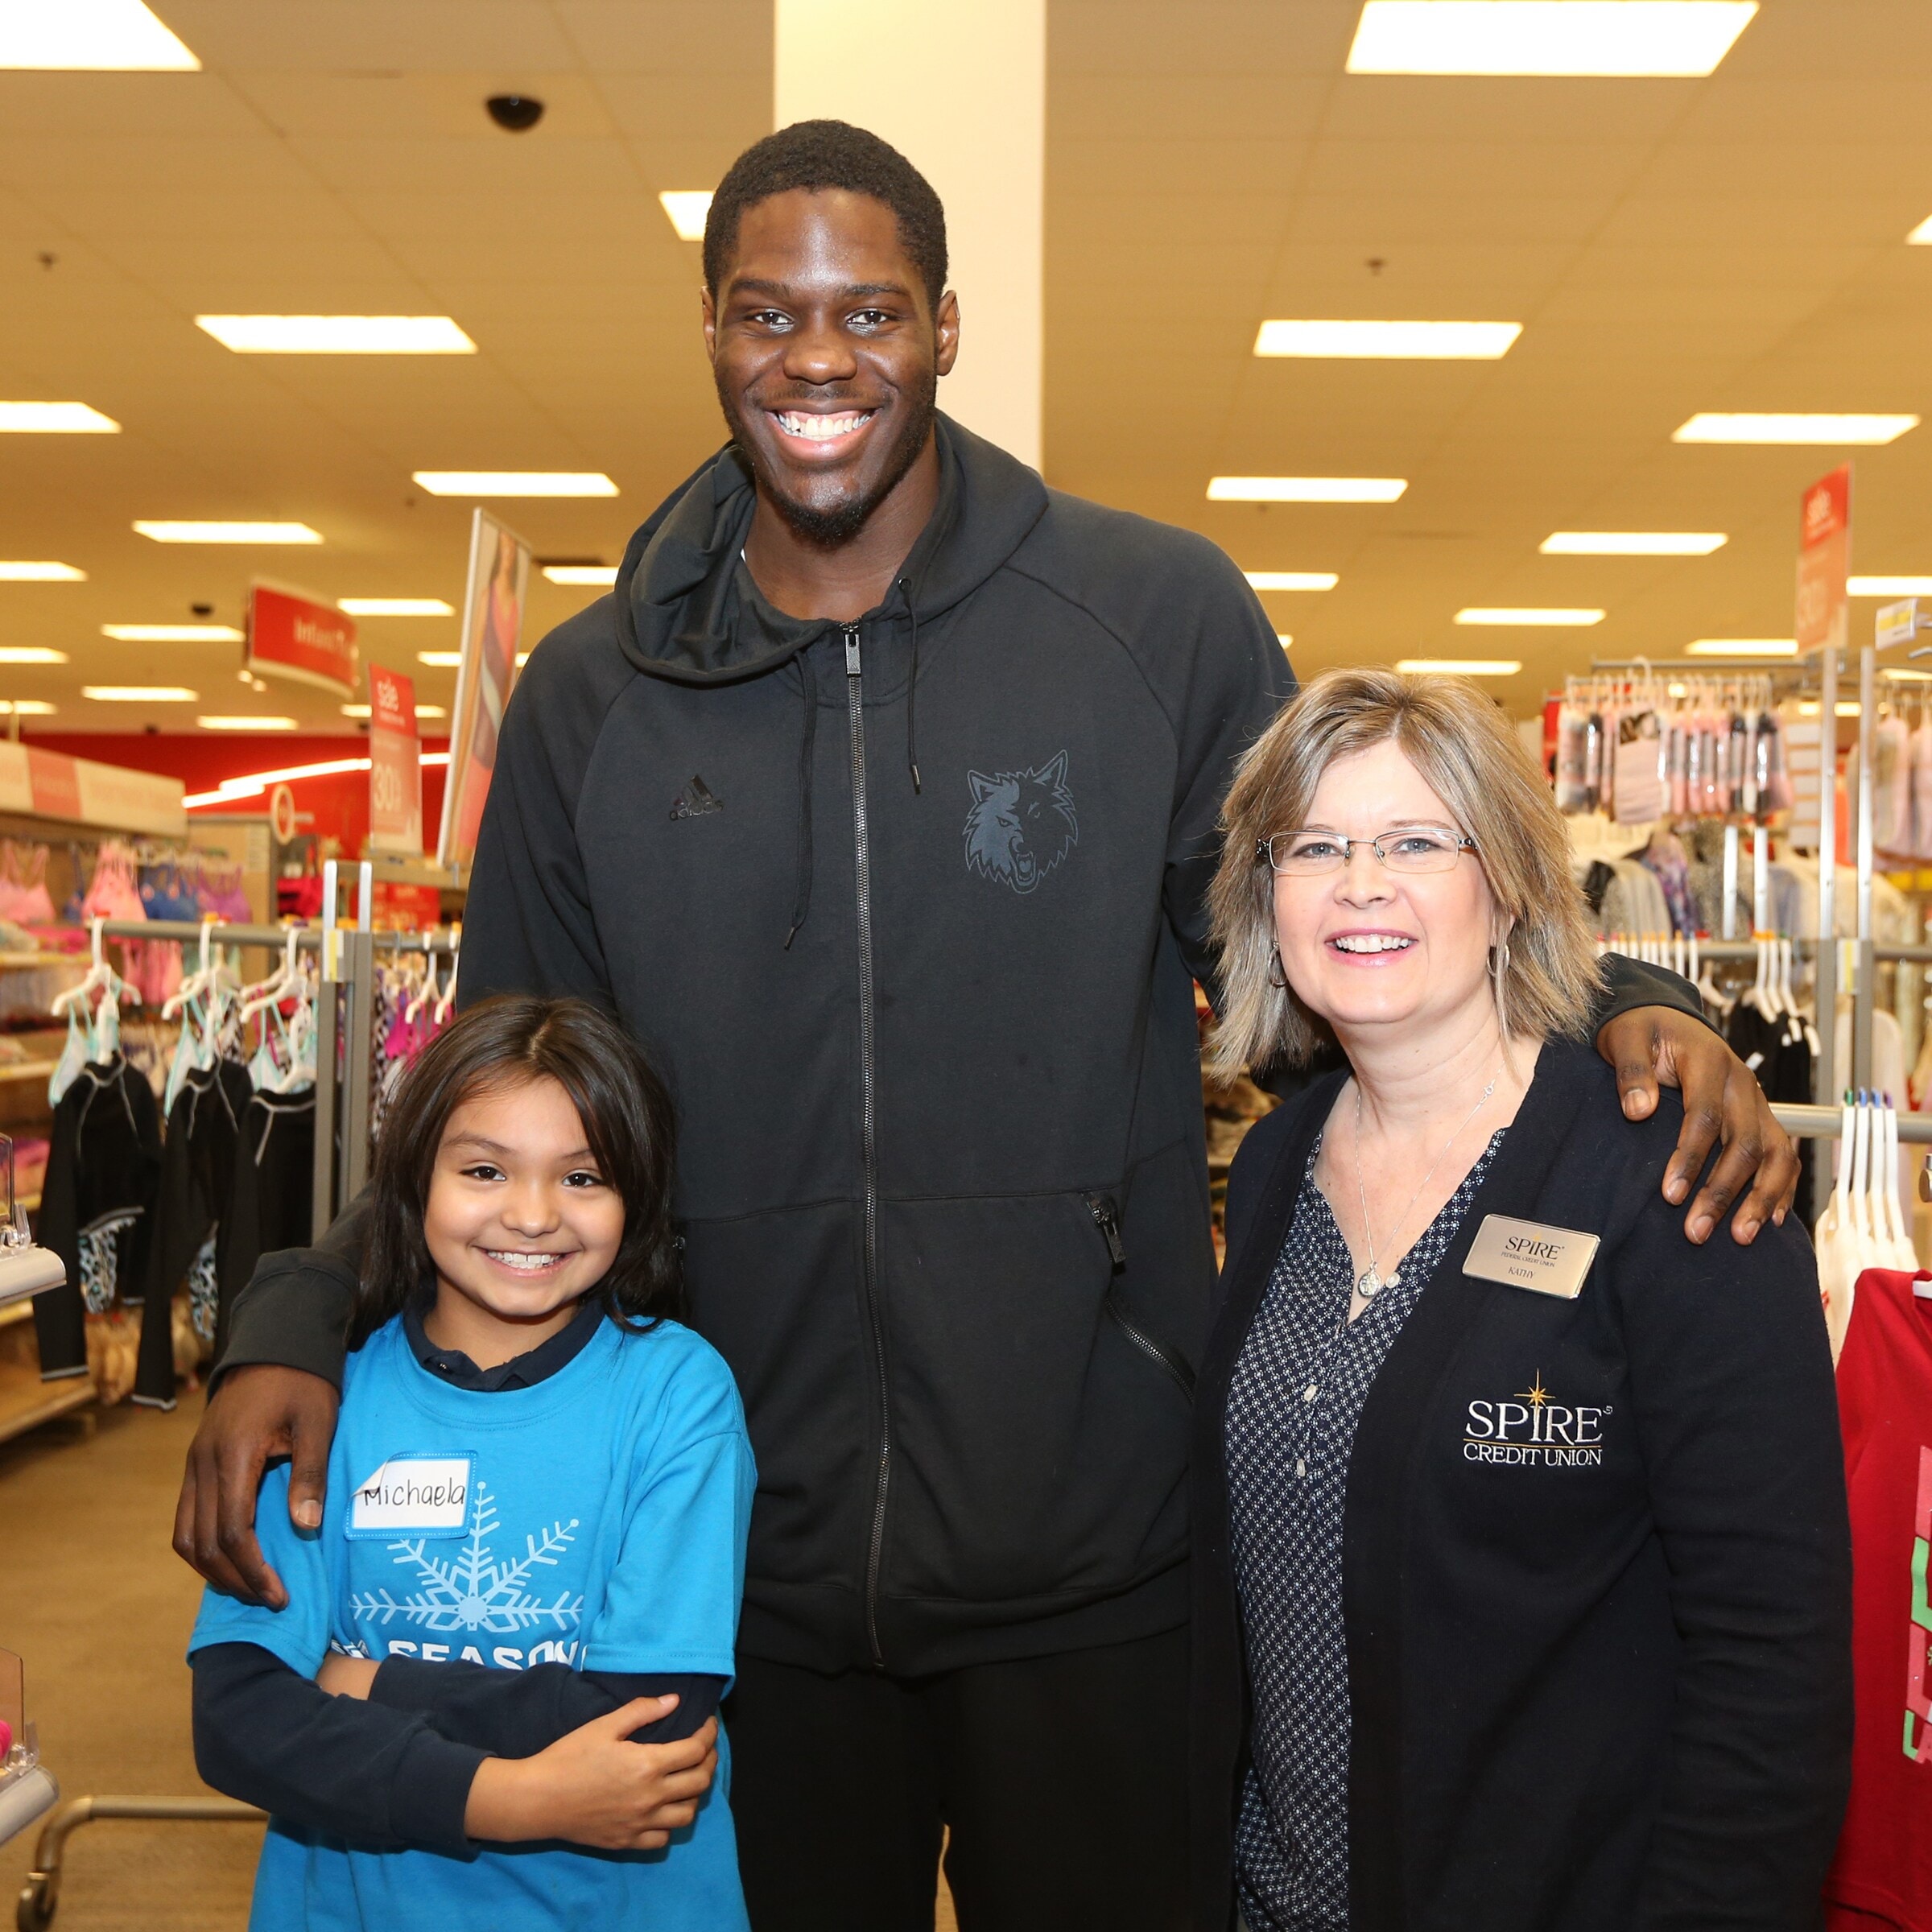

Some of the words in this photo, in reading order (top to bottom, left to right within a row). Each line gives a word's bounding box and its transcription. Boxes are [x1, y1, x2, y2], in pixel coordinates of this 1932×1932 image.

[1501, 1251, 1522, 1261] FEDERAL
[1521, 1256, 1539, 1265] CREDIT
[1539, 1260, 1556, 1268] UNION
[1505, 1236, 1561, 1260] SPIRE
[1508, 1266, 1536, 1279] KATHY
[1465, 1400, 1603, 1445] SPIRE
[1463, 1443, 1541, 1465] CREDIT
[1545, 1449, 1603, 1467] UNION
[364, 1476, 466, 1507] Michaela
